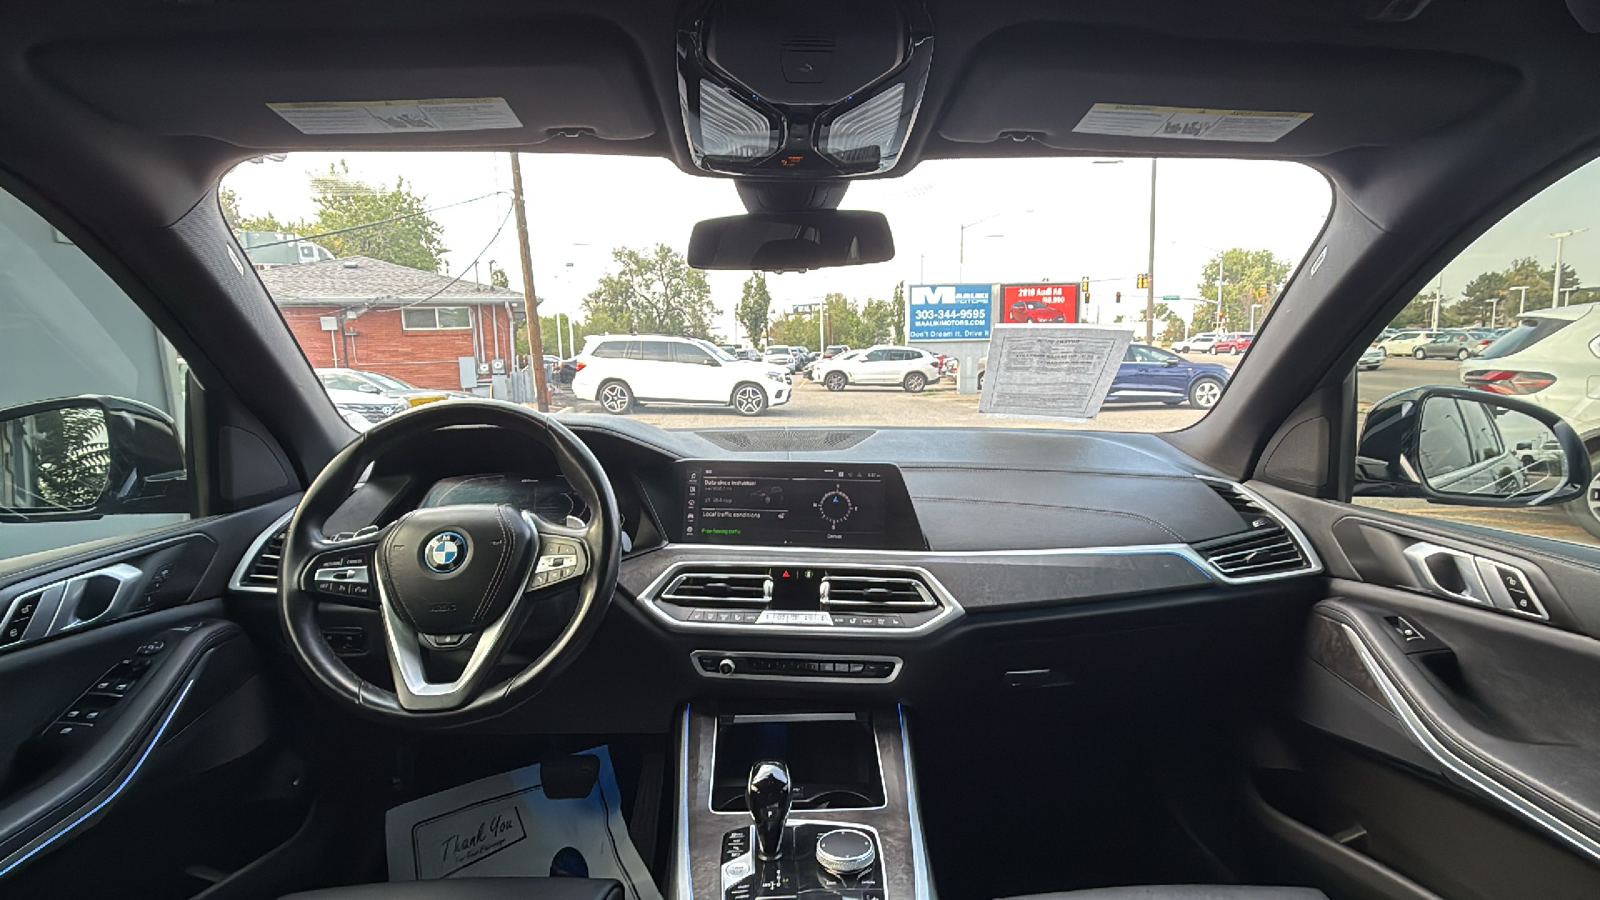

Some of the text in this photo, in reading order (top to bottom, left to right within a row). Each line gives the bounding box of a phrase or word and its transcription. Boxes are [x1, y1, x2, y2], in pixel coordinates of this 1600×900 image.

[1036, 287, 1052, 296] Audi
[915, 309, 986, 320] 303-344-9595
[442, 822, 486, 862] Thank
[490, 815, 512, 838] You
